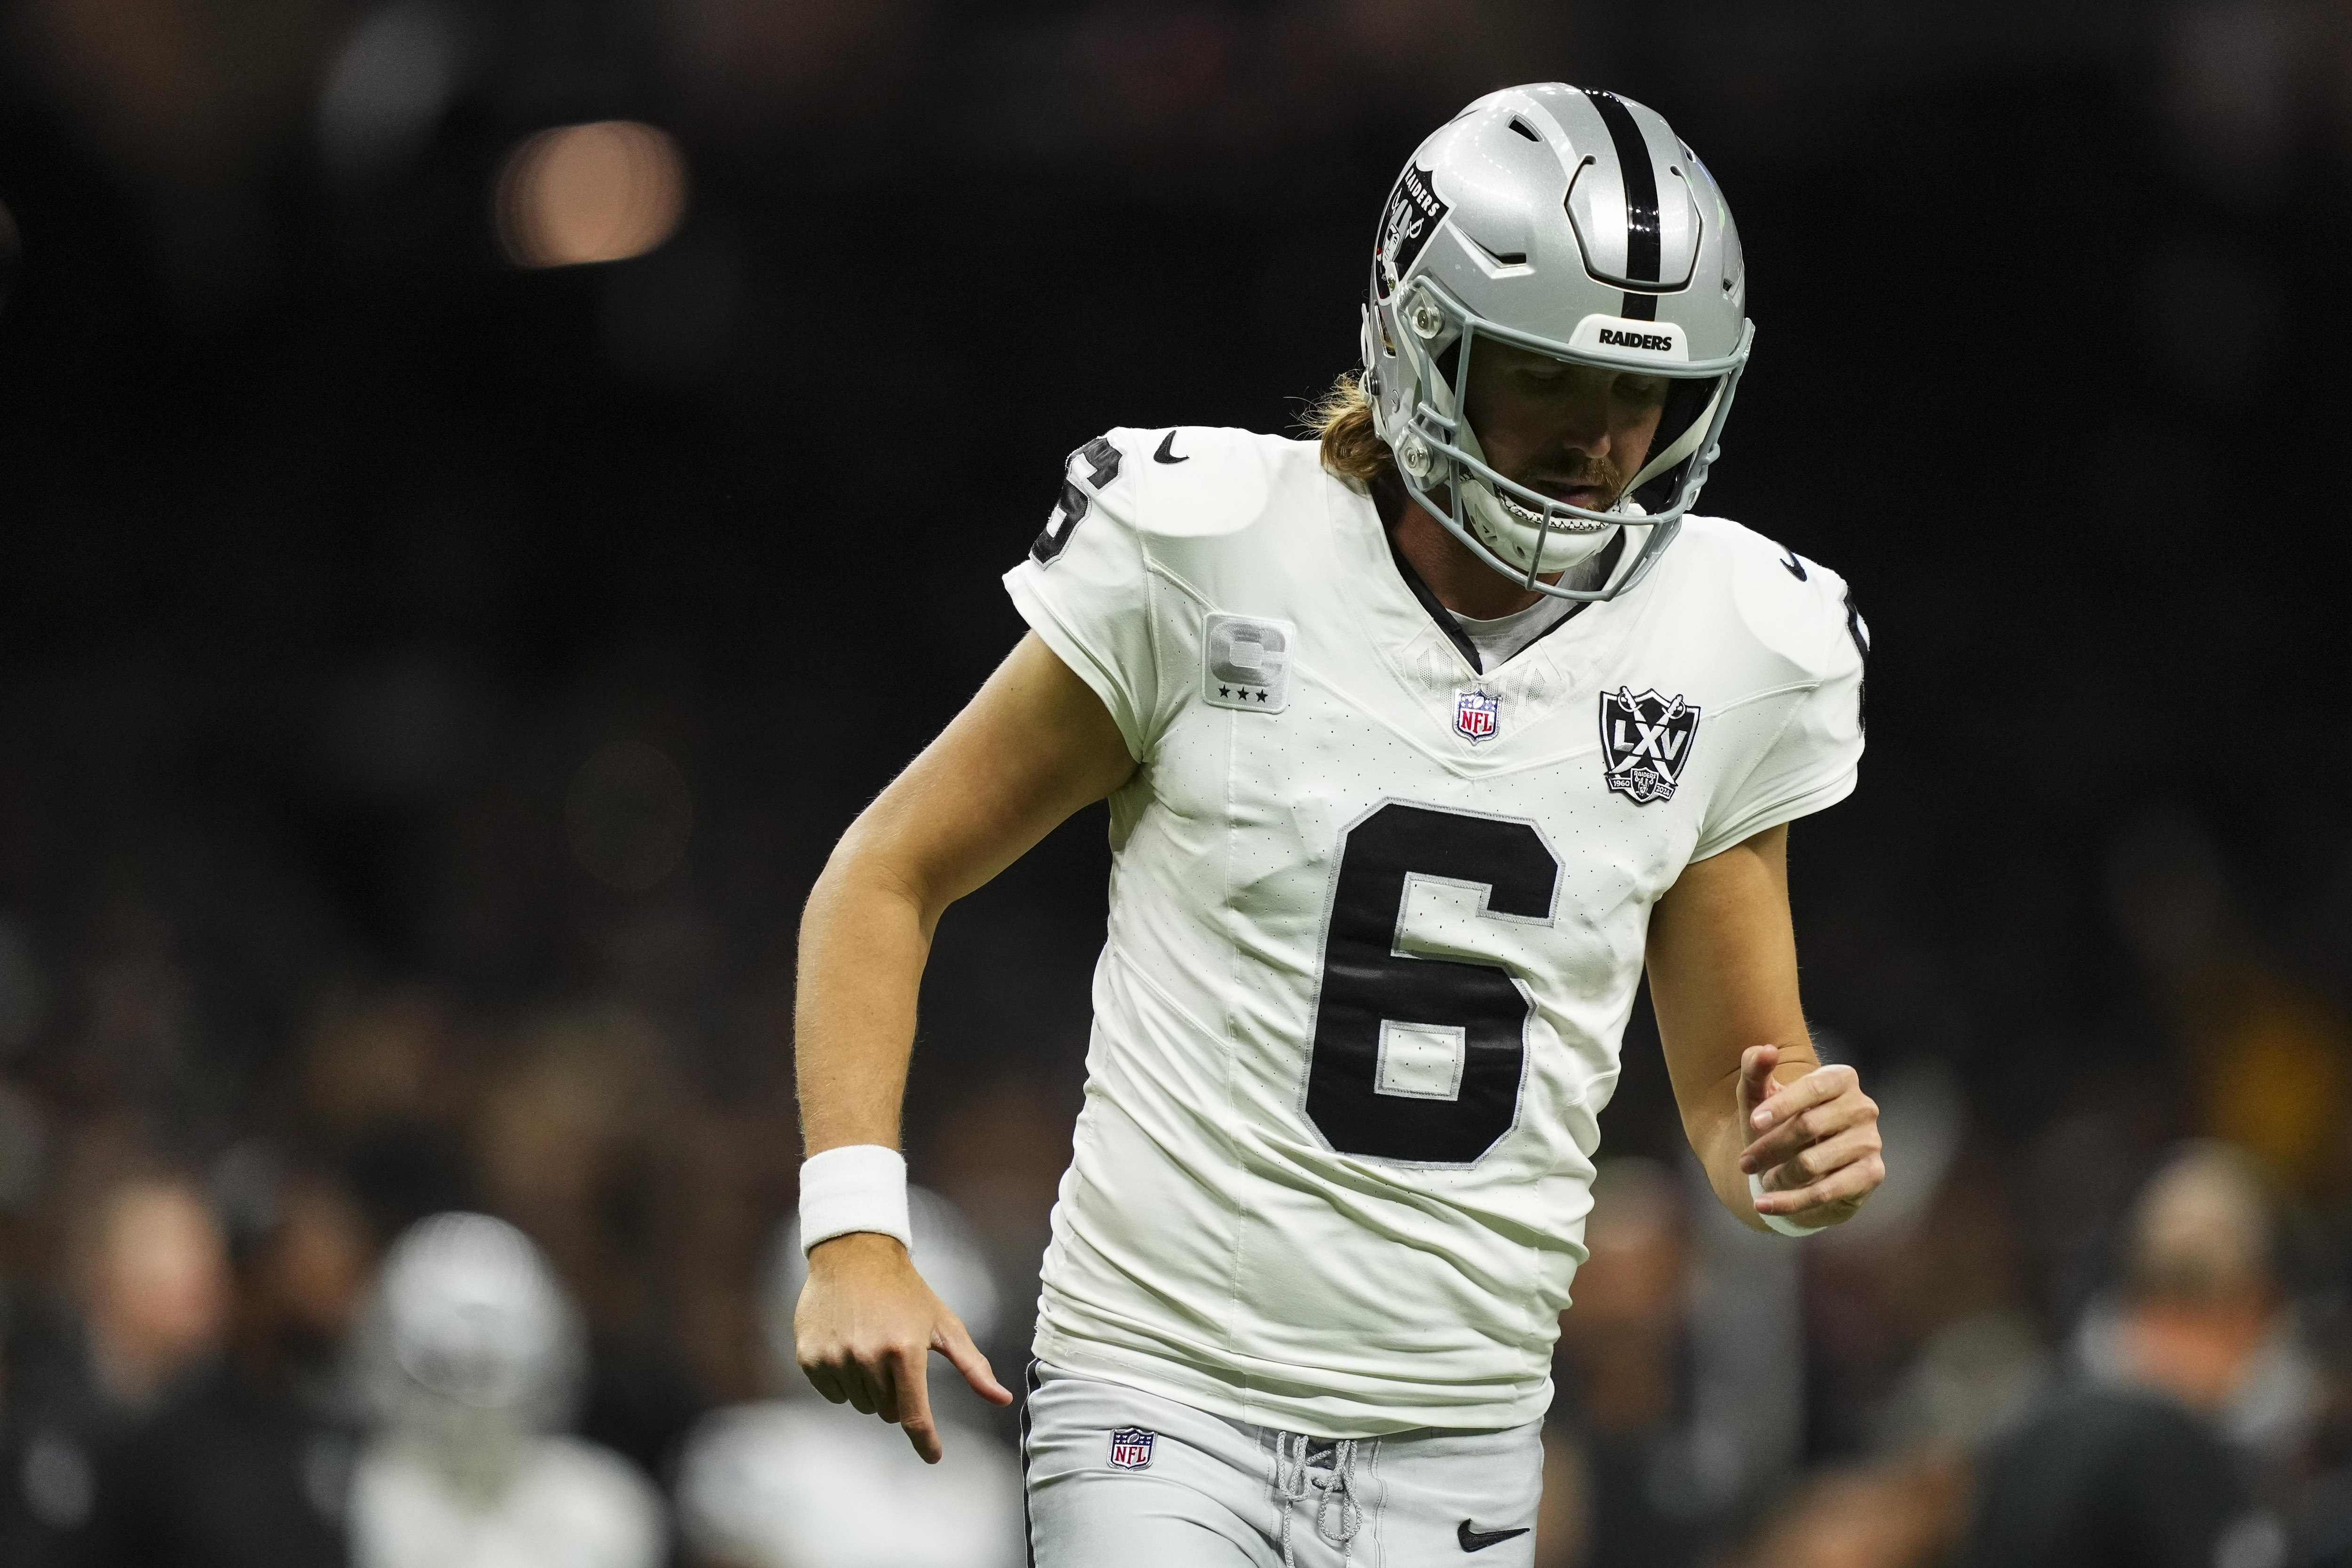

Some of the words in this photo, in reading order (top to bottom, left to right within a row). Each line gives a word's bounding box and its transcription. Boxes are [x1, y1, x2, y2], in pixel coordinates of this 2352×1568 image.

[1405, 167, 1440, 216] RAIDERS
[1599, 329, 1672, 351] RAIDERS
[1210, 621, 1285, 686] C
[1461, 711, 1492, 733] NFL
[1613, 719, 1687, 760] LXV
[1634, 771, 1657, 779] RAIDERS
[1656, 786, 1670, 796] 2024
[1297, 796, 1565, 1170] 6
[1114, 1446, 1146, 1464] NFL
